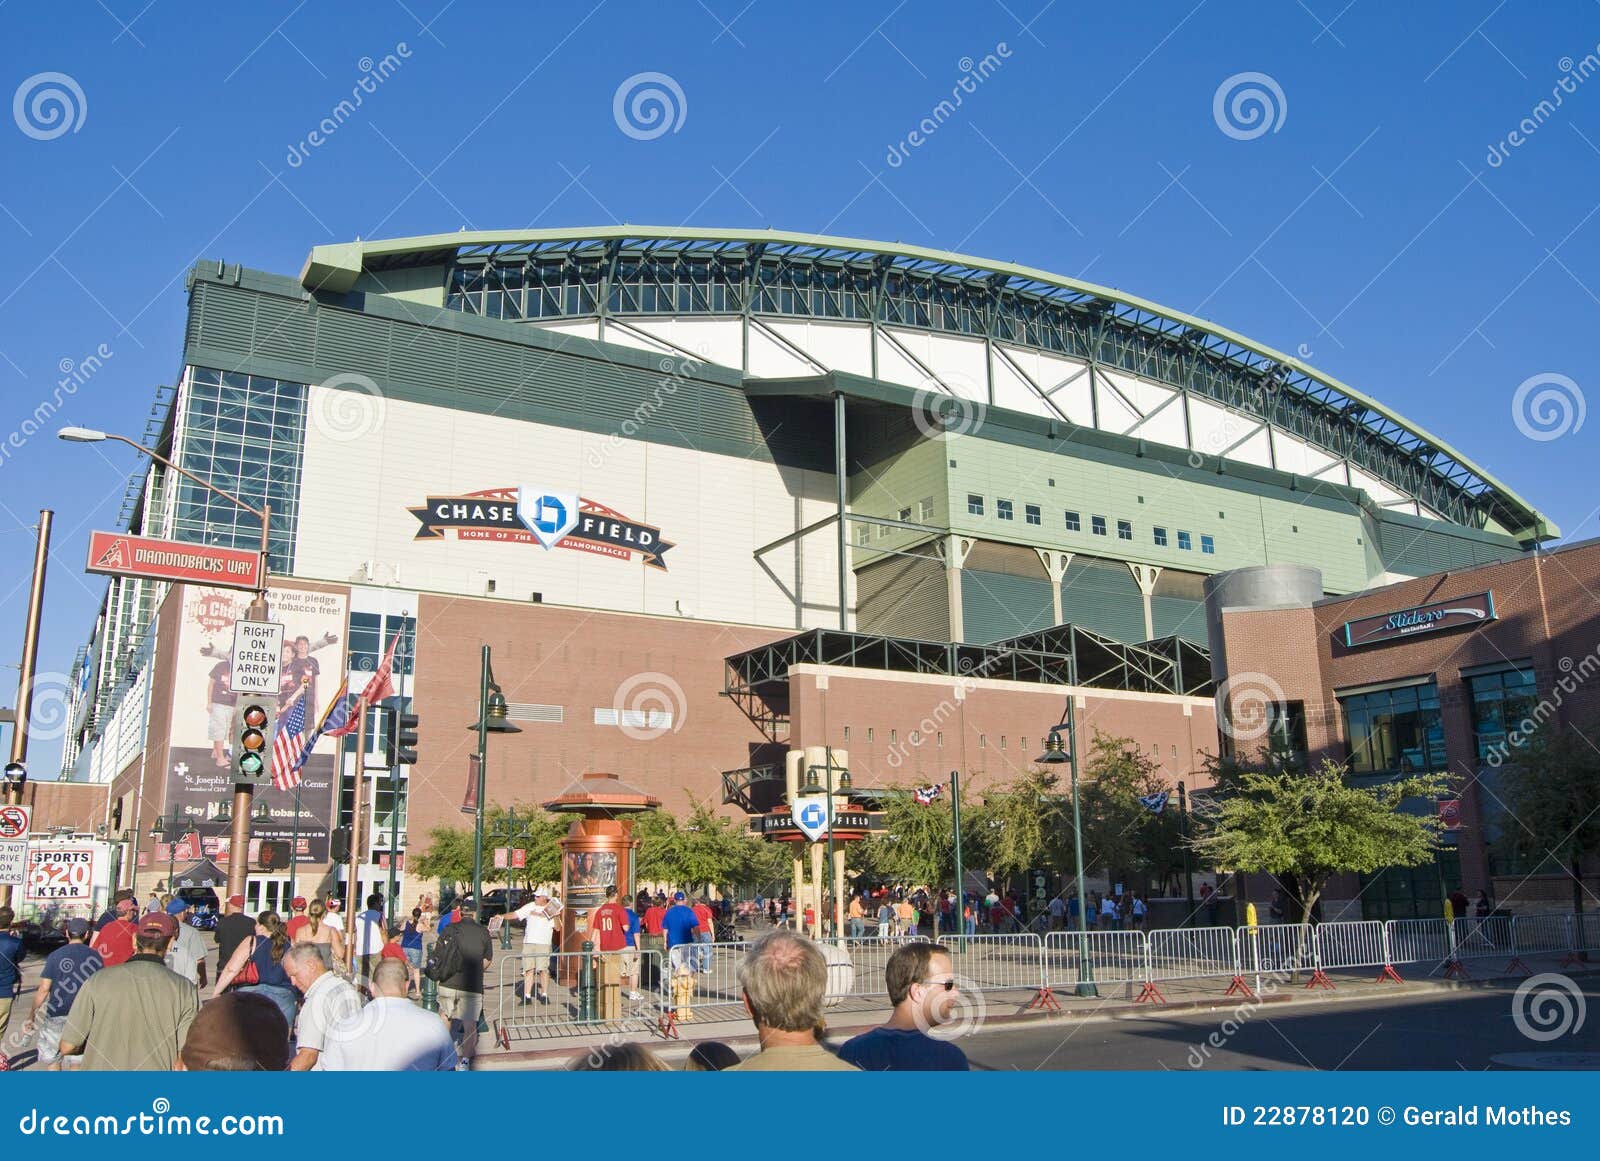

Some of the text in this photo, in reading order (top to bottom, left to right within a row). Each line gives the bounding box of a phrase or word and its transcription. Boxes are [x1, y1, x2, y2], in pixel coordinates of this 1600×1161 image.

[436, 504, 653, 546] CHASE FIELD
[463, 531, 628, 558] HOME OF THE DIAMONDBACKS
[135, 548, 253, 576] DIAMONDBACKS WAY
[281, 592, 301, 601] your
[304, 594, 336, 605] pledge
[278, 603, 316, 613] tobacco
[319, 606, 341, 616] free!
[243, 626, 276, 638] RIGHT
[251, 640, 266, 650] ON
[238, 651, 276, 663] GREEN
[236, 664, 276, 675] ARROW
[241, 676, 270, 687] ONLY
[304, 779, 329, 788] Center
[184, 806, 205, 817] Say
[270, 807, 313, 818] tobaco.
[837, 817, 869, 826] FIELD
[0, 854, 20, 862] RIVE
[34, 853, 89, 862] SPORTS
[0, 873, 22, 882] ACKS
[30, 863, 91, 887] 620
[37, 886, 79, 896] KTAR
[602, 917, 613, 931] 10
